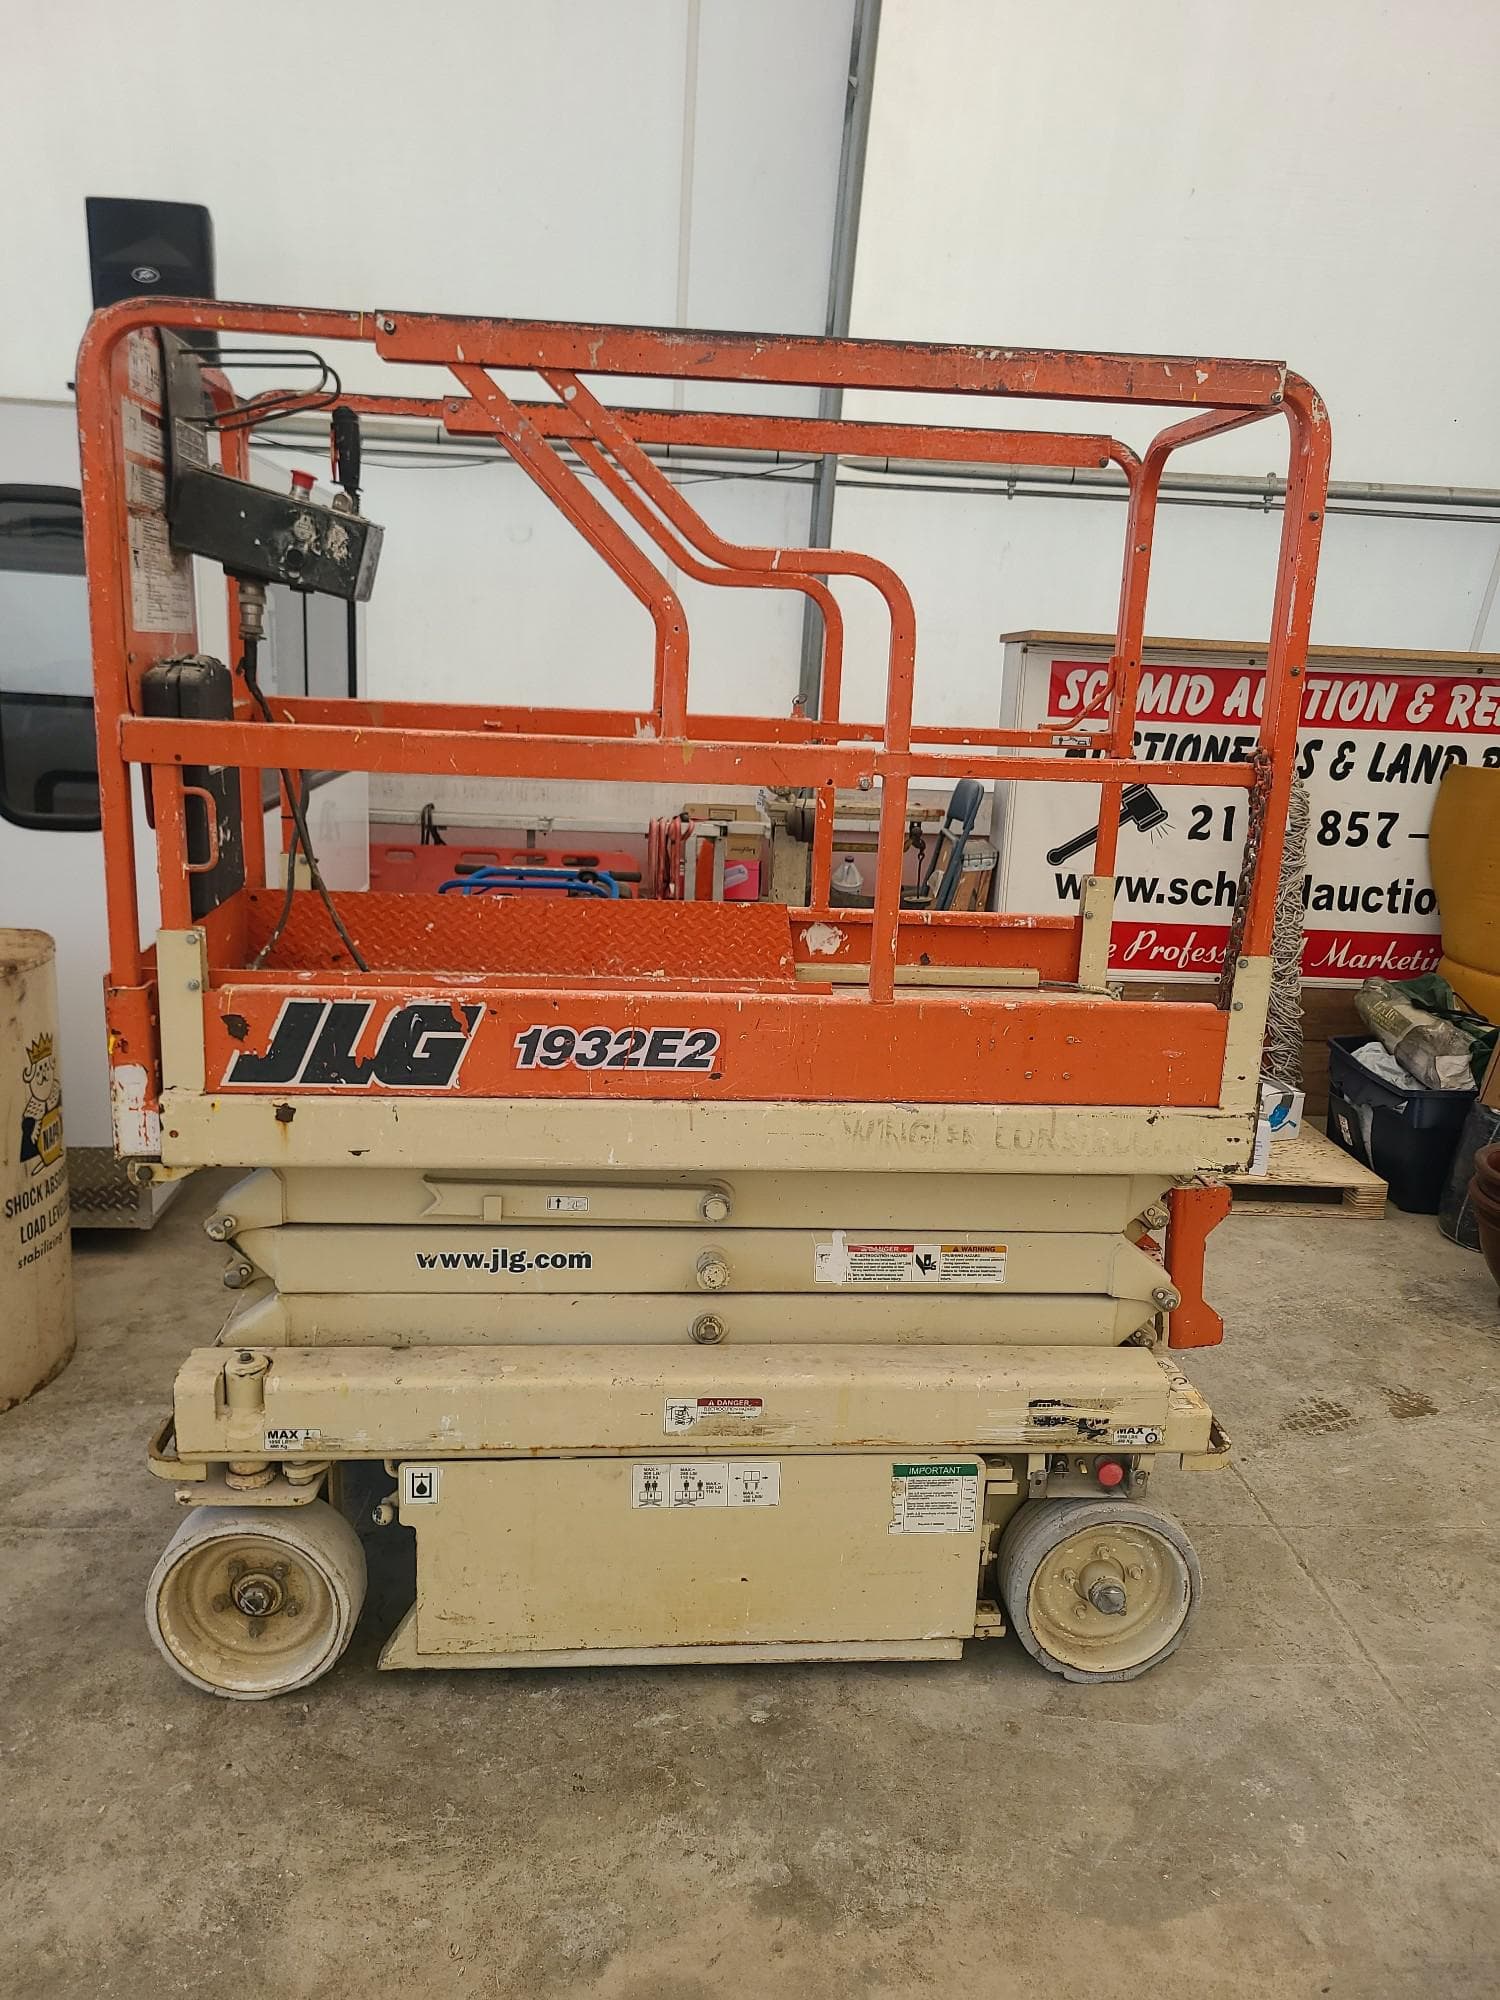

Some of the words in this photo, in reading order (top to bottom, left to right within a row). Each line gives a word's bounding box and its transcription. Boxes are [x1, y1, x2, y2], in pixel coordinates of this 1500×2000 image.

[1058, 669, 1214, 716] SCMID
[1223, 677, 1398, 723] AUTION
[1406, 684, 1435, 724] &
[1445, 685, 1500, 729] RE
[1329, 741, 1356, 781] &
[1187, 804, 1237, 842] 21
[222, 999, 487, 1089] JLG
[513, 1025, 723, 1072] 1932E2
[5, 1184, 43, 1219] SHOCK
[20, 1214, 47, 1244] LOAD
[416, 1248, 593, 1274] www.jlg.com
[267, 1430, 299, 1440] MAX
[1116, 1427, 1144, 1435] MAX
[908, 1466, 962, 1475] IMPORTANT
